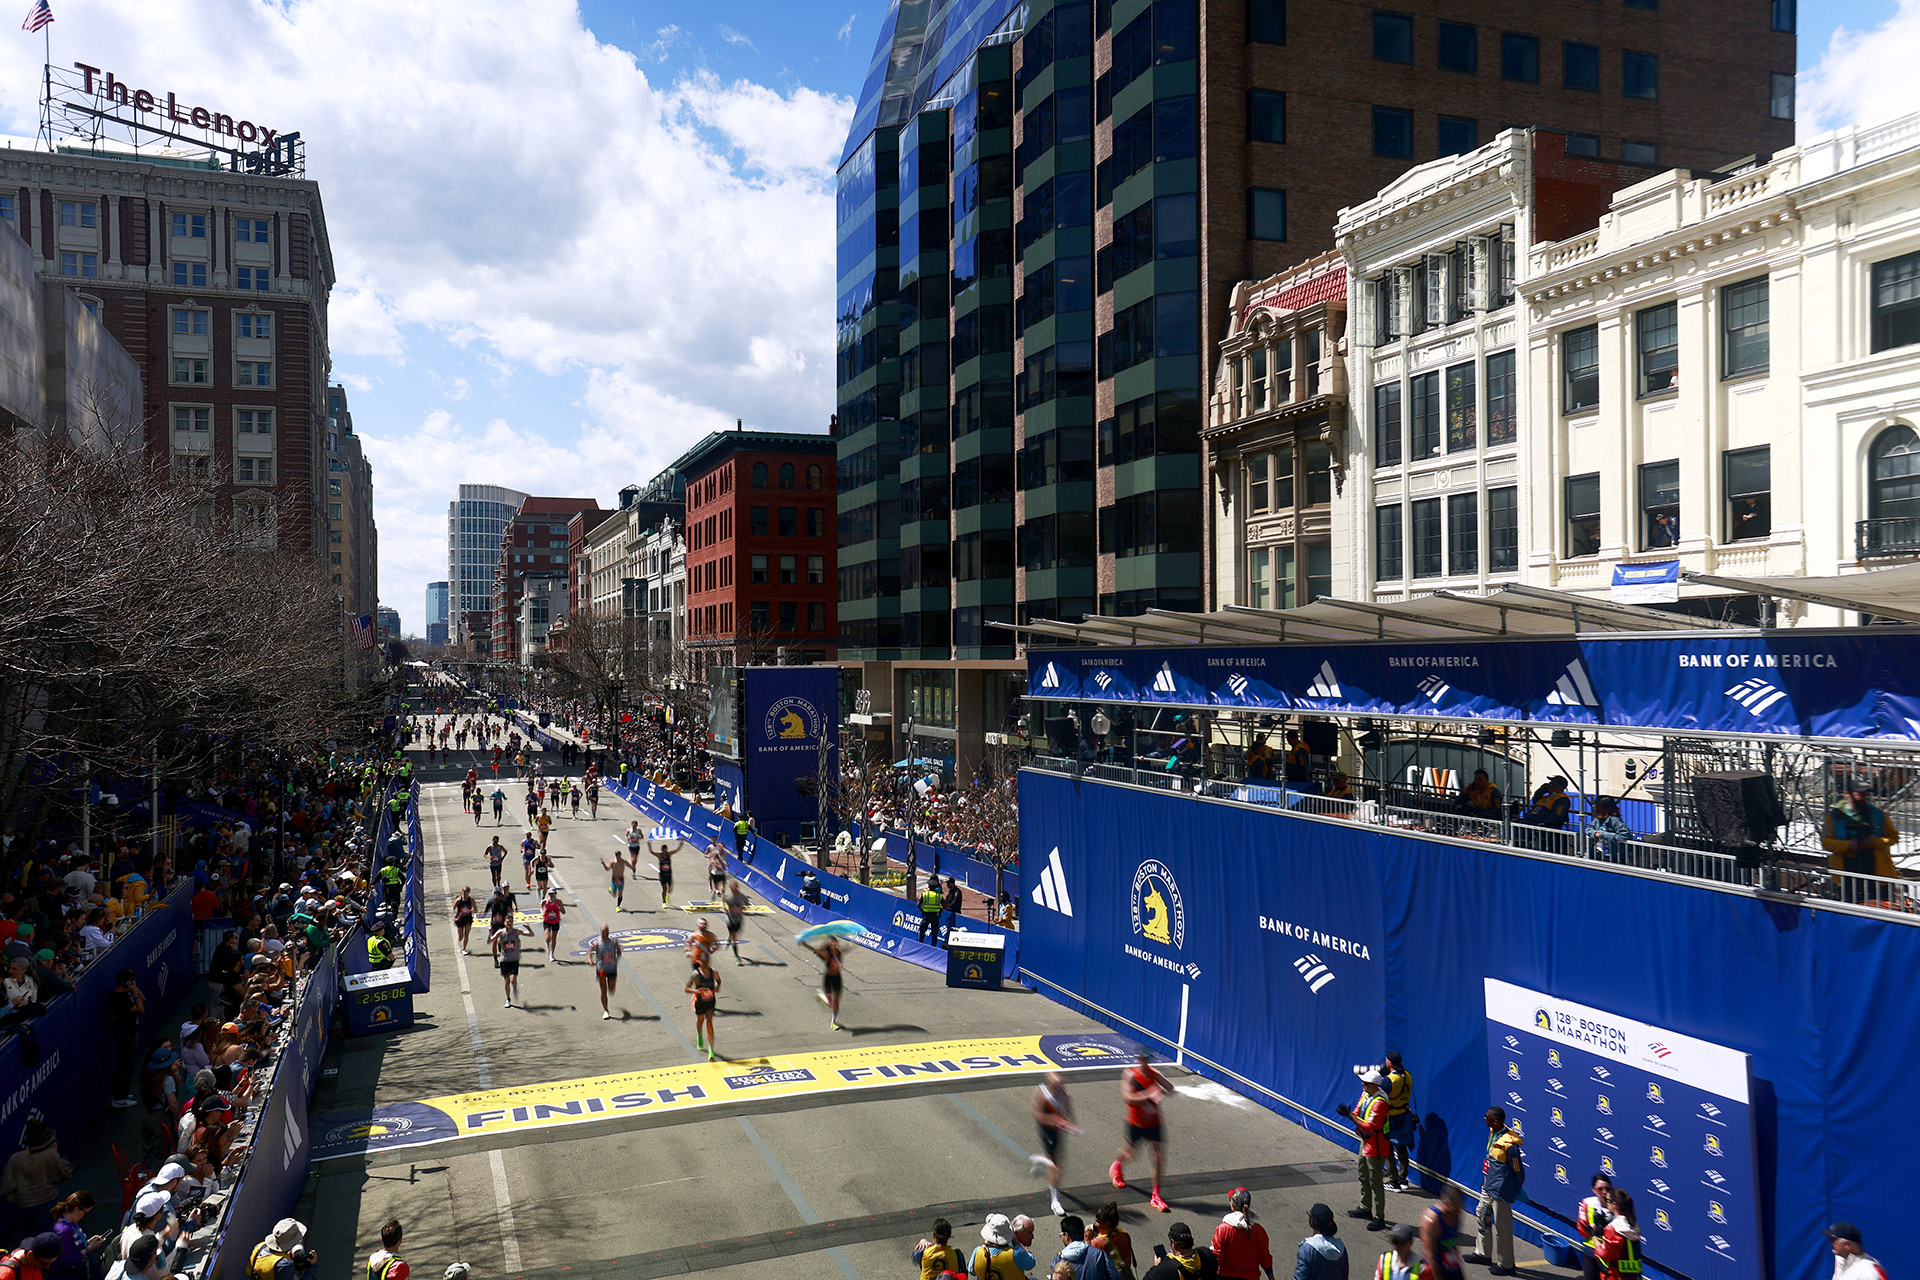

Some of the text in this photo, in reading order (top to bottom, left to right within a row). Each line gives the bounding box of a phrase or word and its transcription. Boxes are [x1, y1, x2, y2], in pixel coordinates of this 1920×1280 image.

[74, 62, 278, 149] The Lenox
[1207, 657, 1266, 667] BANK OF AMERICA
[1389, 656, 1479, 667] BANK OF AMERICA
[1679, 654, 1838, 668] BANK OF AMERICA
[770, 698, 794, 717] BOSTON
[797, 699, 819, 735] MARATHON
[1406, 764, 1461, 799] CAVA
[1135, 863, 1158, 892] BOSTON
[1160, 867, 1183, 940] MARATHON
[905, 913, 914, 923] THE
[1259, 915, 1370, 961] BANK OF AMERICA
[960, 950, 997, 962] 3:21:06
[1124, 943, 1185, 976] BANK OF AMERICA
[362, 987, 406, 1004] 2:56:06
[1557, 1024, 1627, 1055] MARATHON
[1580, 1018, 1626, 1042] BOSTON
[860, 1047, 926, 1057] BOSTON
[933, 1041, 1022, 1050] MARATHON
[508, 1083, 585, 1096] BOSTON
[594, 1068, 698, 1086] MARATHON
[836, 1054, 1049, 1082] FINISH
[1, 1090, 18, 1124] ANK
[20, 1078, 30, 1104] OF
[465, 1084, 708, 1129] FINISH
[312, 1141, 342, 1149] BANK
[363, 1130, 413, 1141] AMERICA
